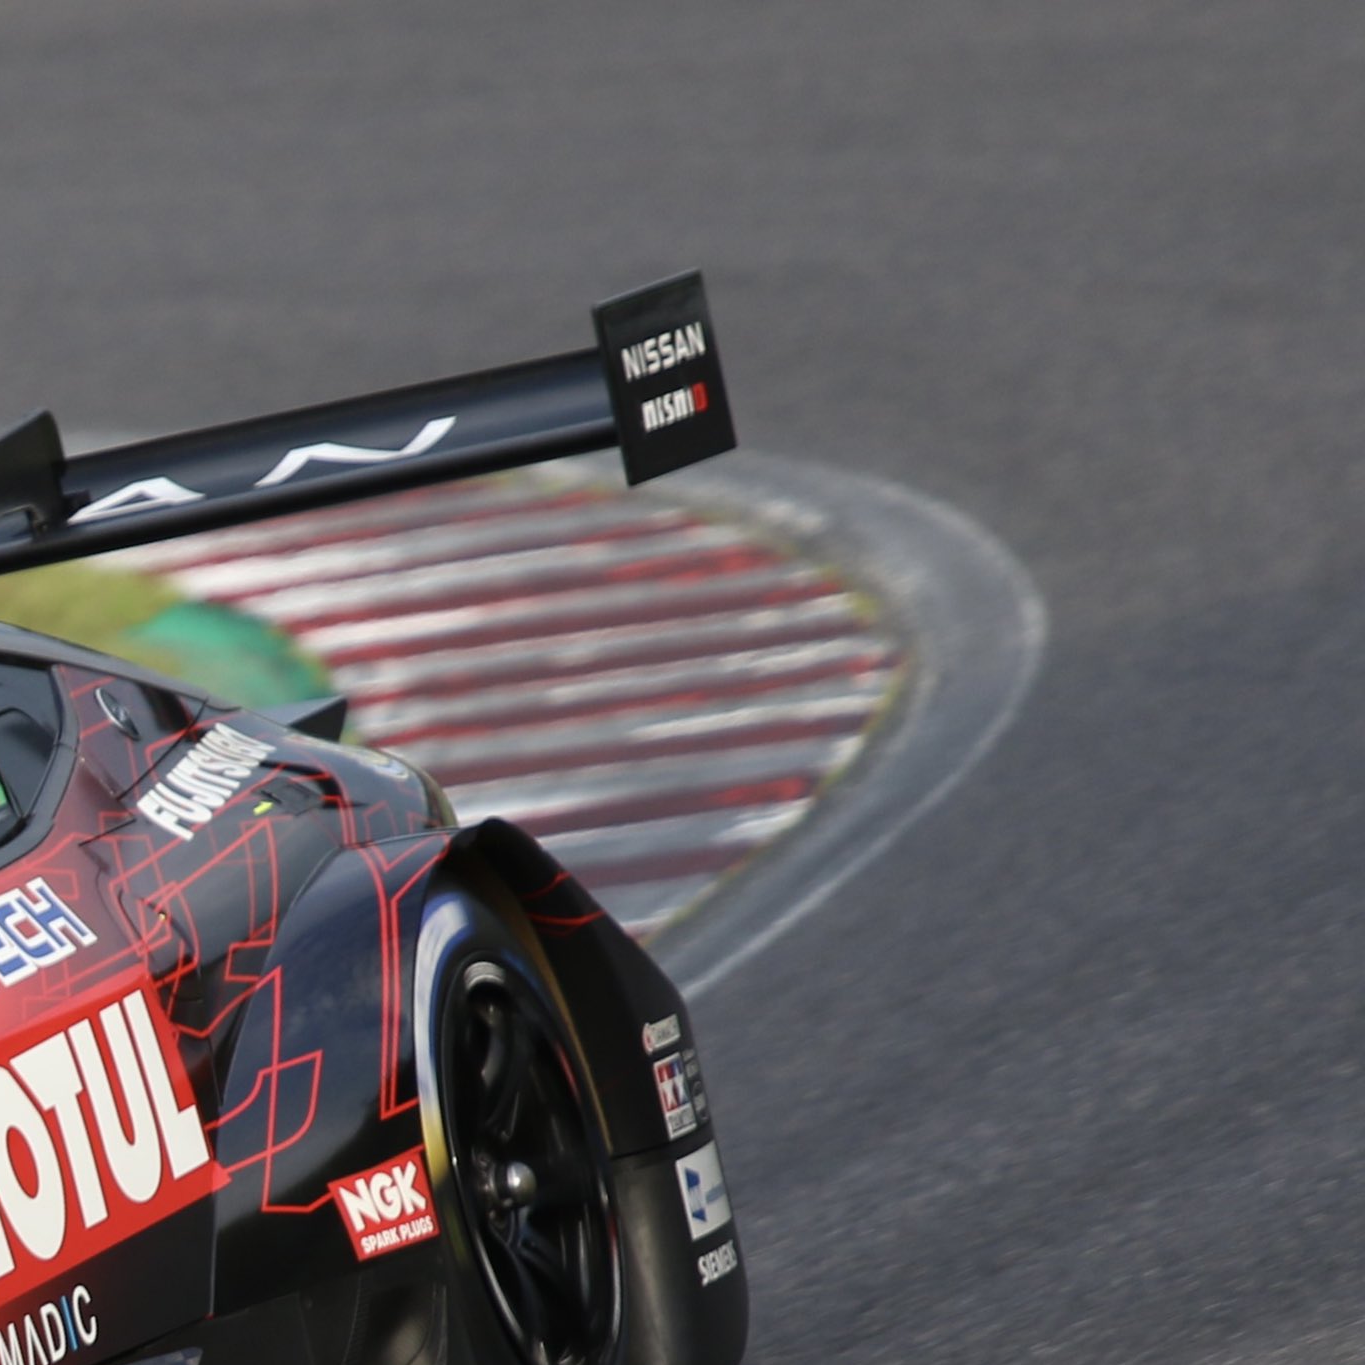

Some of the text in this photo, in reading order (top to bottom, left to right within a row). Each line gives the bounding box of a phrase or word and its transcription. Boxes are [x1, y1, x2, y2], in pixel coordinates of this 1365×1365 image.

[621, 321, 706, 382] NISSAN
[339, 1160, 427, 1233] NGK
[360, 1215, 434, 1255] SPARK PLUGS
